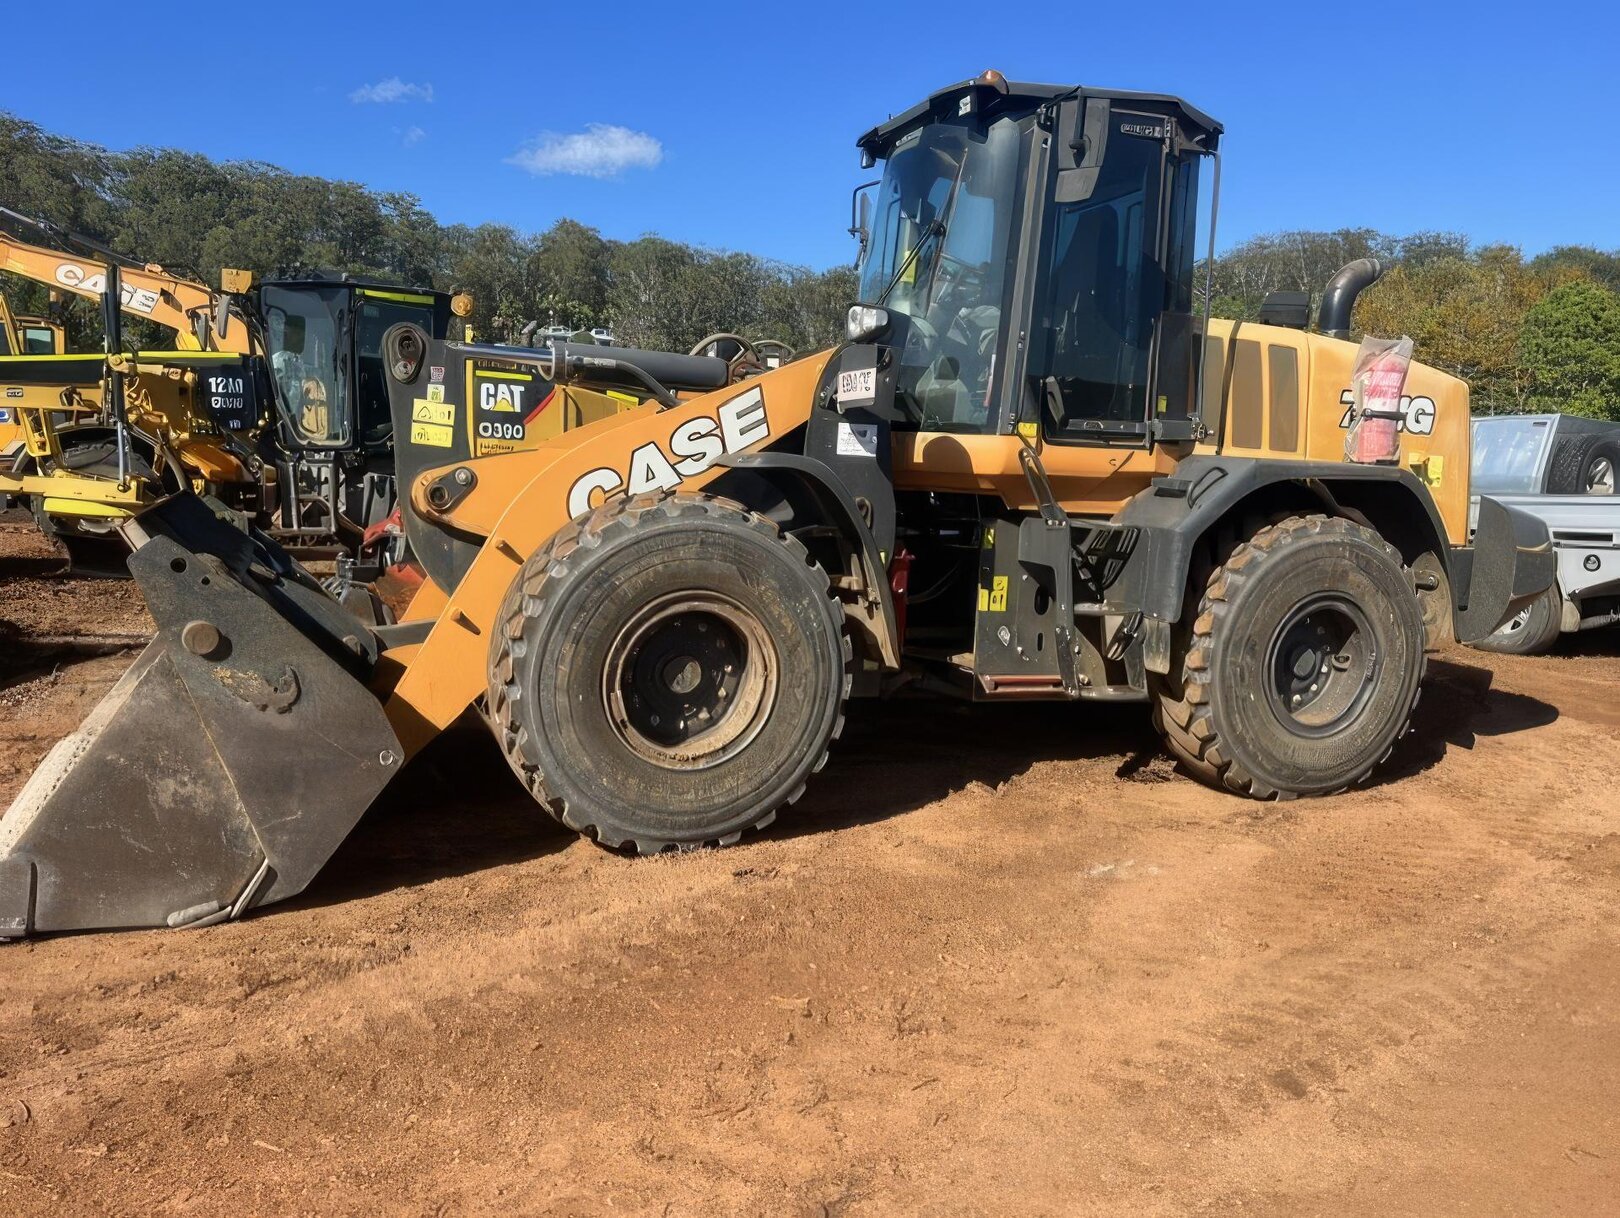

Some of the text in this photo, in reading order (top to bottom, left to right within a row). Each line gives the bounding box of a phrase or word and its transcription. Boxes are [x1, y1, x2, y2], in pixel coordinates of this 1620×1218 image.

[480, 382, 525, 413] CAT
[1338, 388, 1437, 436] 7G
[566, 383, 770, 521] CASE
